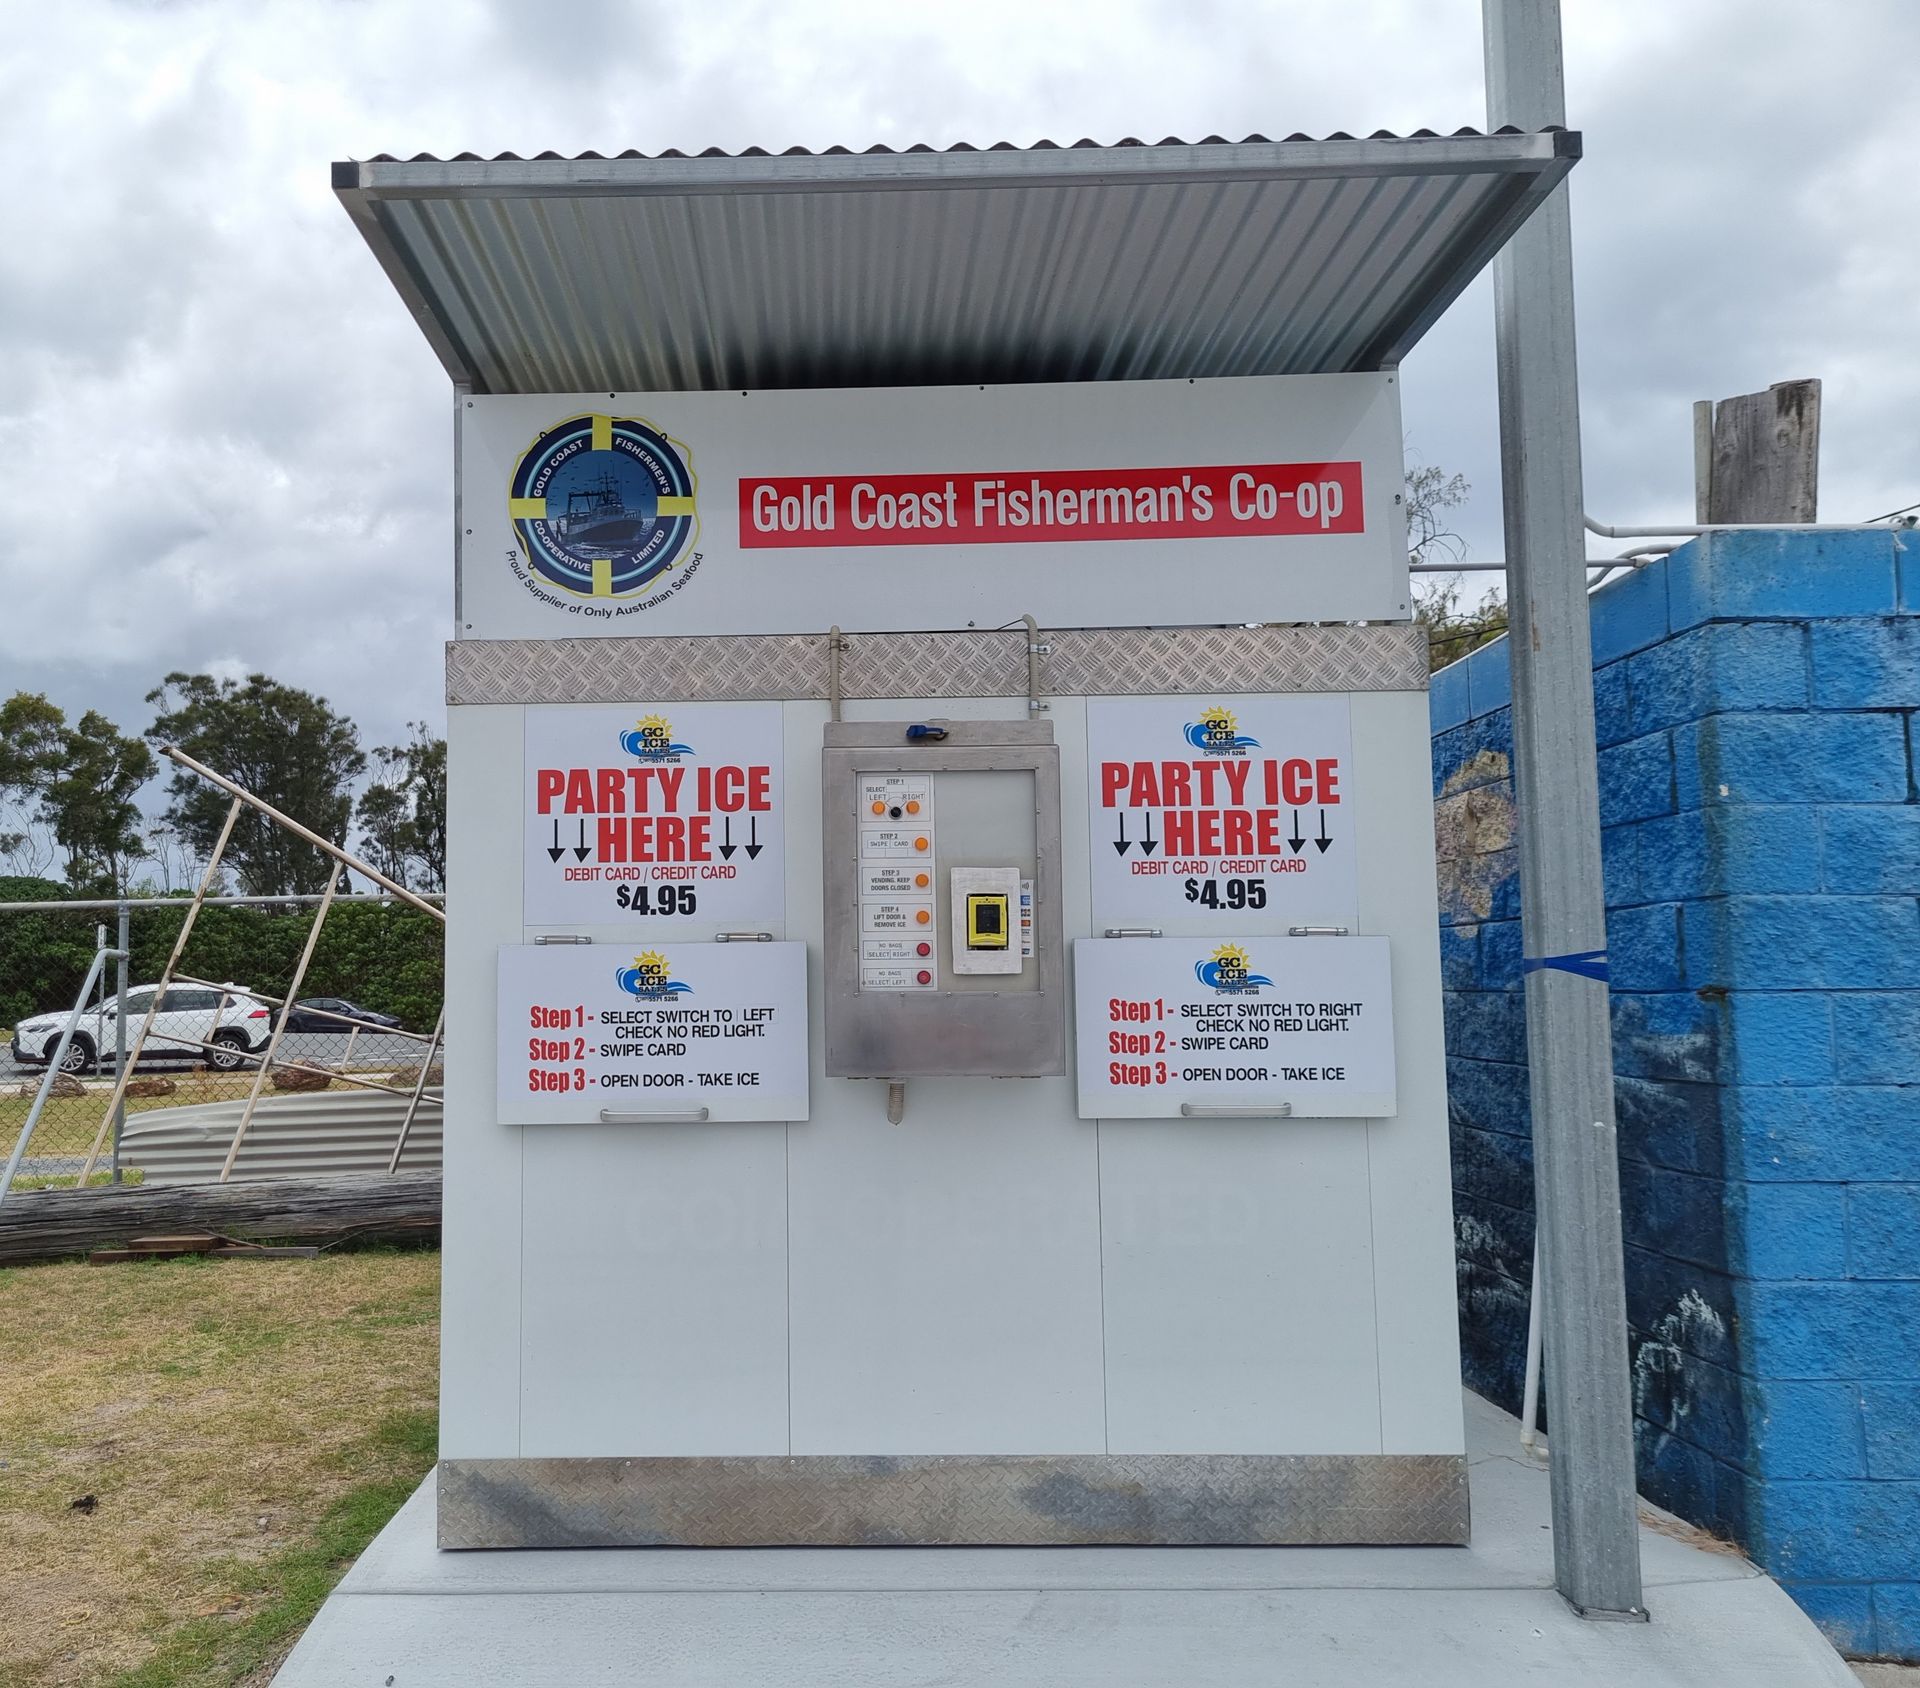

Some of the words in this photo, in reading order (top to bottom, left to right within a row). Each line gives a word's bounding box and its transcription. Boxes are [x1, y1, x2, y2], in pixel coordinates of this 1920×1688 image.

[534, 468, 551, 497] GOLD
[550, 440, 583, 467] COAST
[615, 437, 671, 494] FISHERMEN'S
[753, 484, 835, 533] Gold
[851, 481, 958, 530] Coast
[974, 475, 1214, 528] Fisherman's
[1229, 473, 1343, 528] Co-op
[534, 520, 591, 572] CO-OPERATIVE
[631, 529, 665, 564] LIMITED
[506, 550, 525, 581] Proud
[524, 578, 566, 610] Supplier
[569, 605, 582, 616] of
[584, 607, 613, 619] Only
[615, 589, 674, 617] Australian
[671, 552, 703, 590] Seafood
[641, 727, 664, 737] GC
[1206, 720, 1228, 730] GC
[1207, 731, 1234, 740] ICE
[642, 738, 669, 748] ICE
[537, 767, 685, 814] PARTY
[697, 766, 771, 812] ICE
[1101, 760, 1251, 807] PARTY
[1264, 758, 1341, 805] ICE
[597, 816, 712, 863] HERE
[1163, 809, 1281, 856] HERE
[565, 867, 601, 881] DEBIT
[605, 867, 640, 881] CARD
[651, 866, 697, 880] CREDIT
[701, 865, 736, 879] CARD
[1132, 861, 1168, 875] DEBIT
[1172, 861, 1209, 874] CARD
[1219, 860, 1266, 873] CREDIT
[1270, 859, 1306, 872] CARD
[616, 884, 697, 915] $4.95
[1185, 877, 1267, 910] $4.95
[639, 964, 660, 975] GC
[1218, 957, 1240, 968] GC
[1219, 969, 1247, 979] ICE
[639, 976, 667, 986] ICE
[530, 1006, 572, 1030] Step
[575, 1005, 583, 1027] 1
[601, 1011, 652, 1024] SELECT
[656, 1010, 709, 1023] SWITCH
[714, 1009, 732, 1022] TO
[743, 1008, 775, 1021] LEFT
[1109, 999, 1150, 1023] Step
[1155, 999, 1163, 1020] 1
[1181, 1004, 1233, 1018] SELECT
[1237, 1004, 1292, 1017] SWITCH
[1296, 1003, 1315, 1016] TO
[1319, 1003, 1362, 1016] RIGHT
[615, 1026, 662, 1039] CHECK
[667, 1026, 688, 1038] NO
[692, 1025, 720, 1038] RED
[724, 1025, 765, 1037] LIGHT.
[1196, 1020, 1244, 1032] CHECK
[1250, 1019, 1270, 1032] NO
[1274, 1019, 1303, 1031] RED
[1307, 1018, 1349, 1031] LIGHT.
[529, 1038, 569, 1062] Step
[574, 1037, 584, 1059] 2
[600, 1044, 643, 1057] SWIPE
[647, 1043, 686, 1056] CARD
[1109, 1031, 1150, 1056] Step
[1155, 1030, 1166, 1053] 2
[1181, 1038, 1225, 1050] SWIPE
[1230, 1037, 1268, 1050] CARD
[529, 1069, 570, 1093] Step
[574, 1068, 585, 1090] 3
[601, 1075, 639, 1088] OPEN
[643, 1074, 684, 1087] DOOR
[697, 1073, 733, 1086] TAKE
[737, 1073, 759, 1085] ICE
[1110, 1062, 1151, 1087] Step
[1155, 1061, 1167, 1084] 3
[1183, 1068, 1221, 1081] OPEN
[1226, 1068, 1267, 1081] DOOR
[1281, 1068, 1318, 1081] TAKE
[1322, 1068, 1345, 1080] ICE
